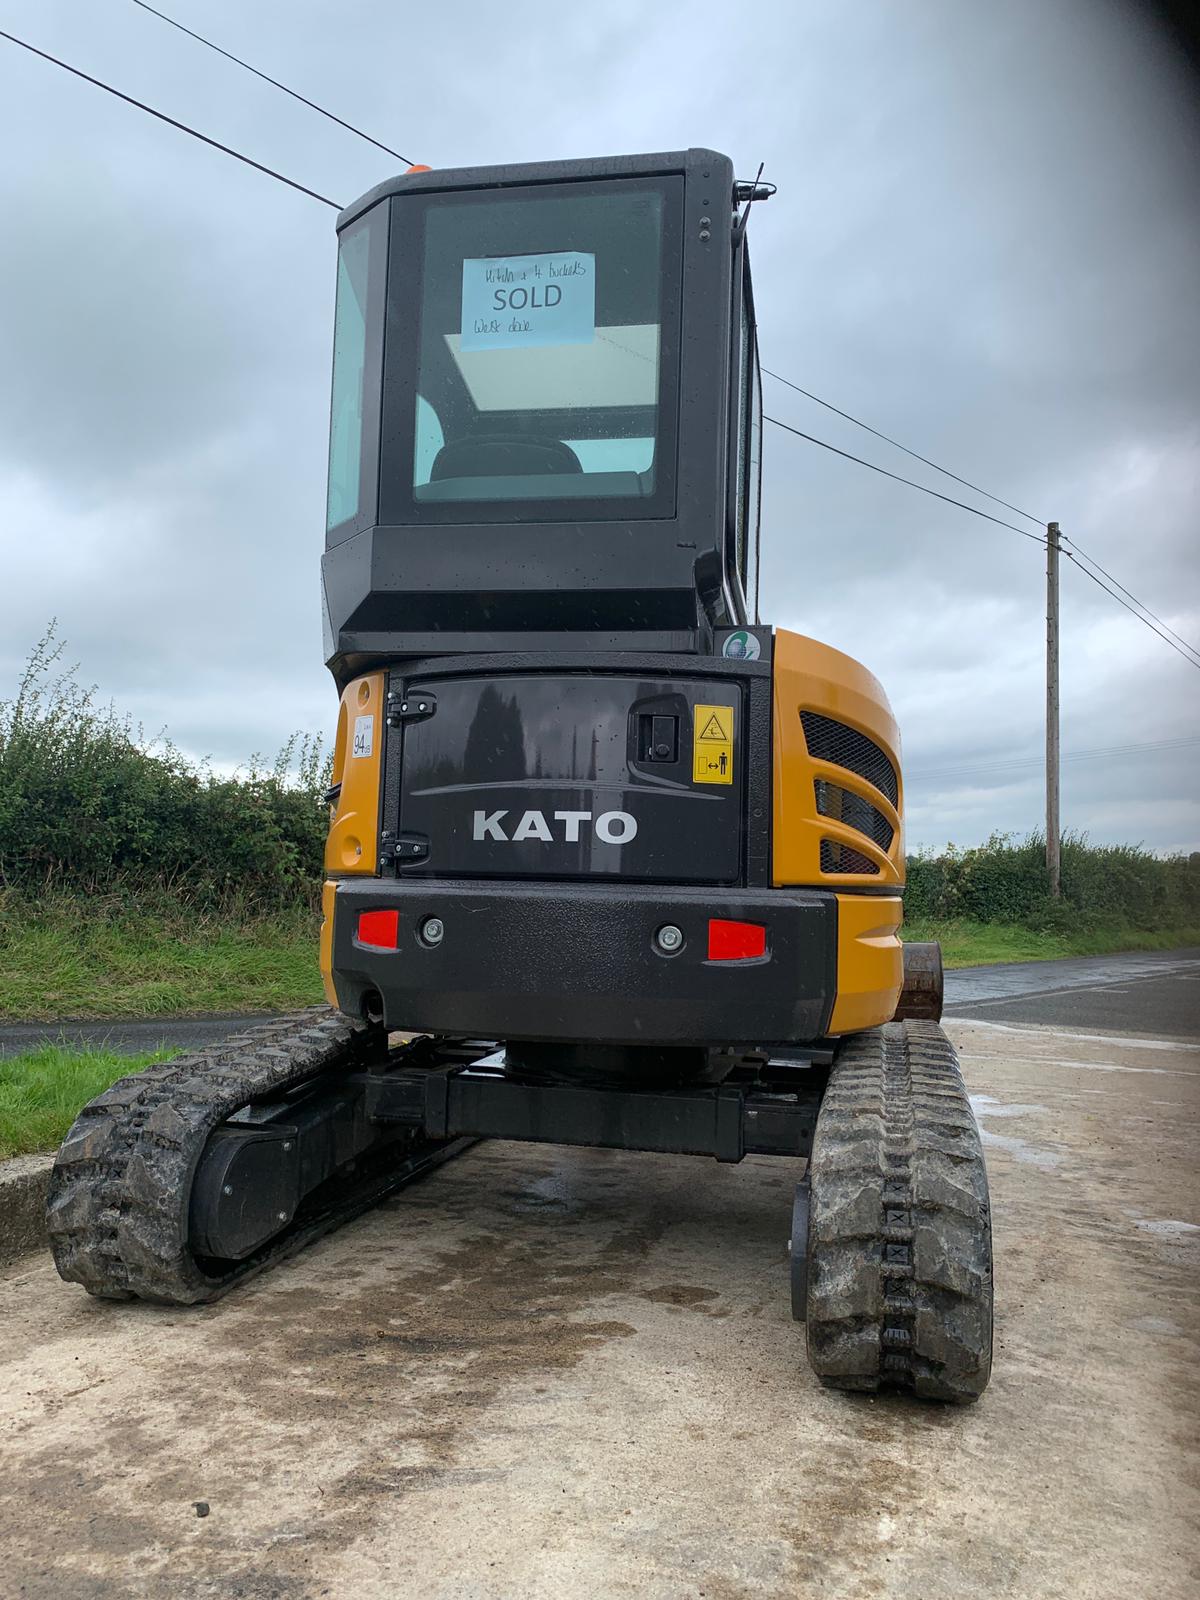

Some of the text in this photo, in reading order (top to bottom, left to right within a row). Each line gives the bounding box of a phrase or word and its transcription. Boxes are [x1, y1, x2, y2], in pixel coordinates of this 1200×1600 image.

[534, 264, 543, 279] 4
[493, 284, 562, 311] SOLD
[354, 734, 365, 754] 94
[473, 810, 638, 844] KATO
